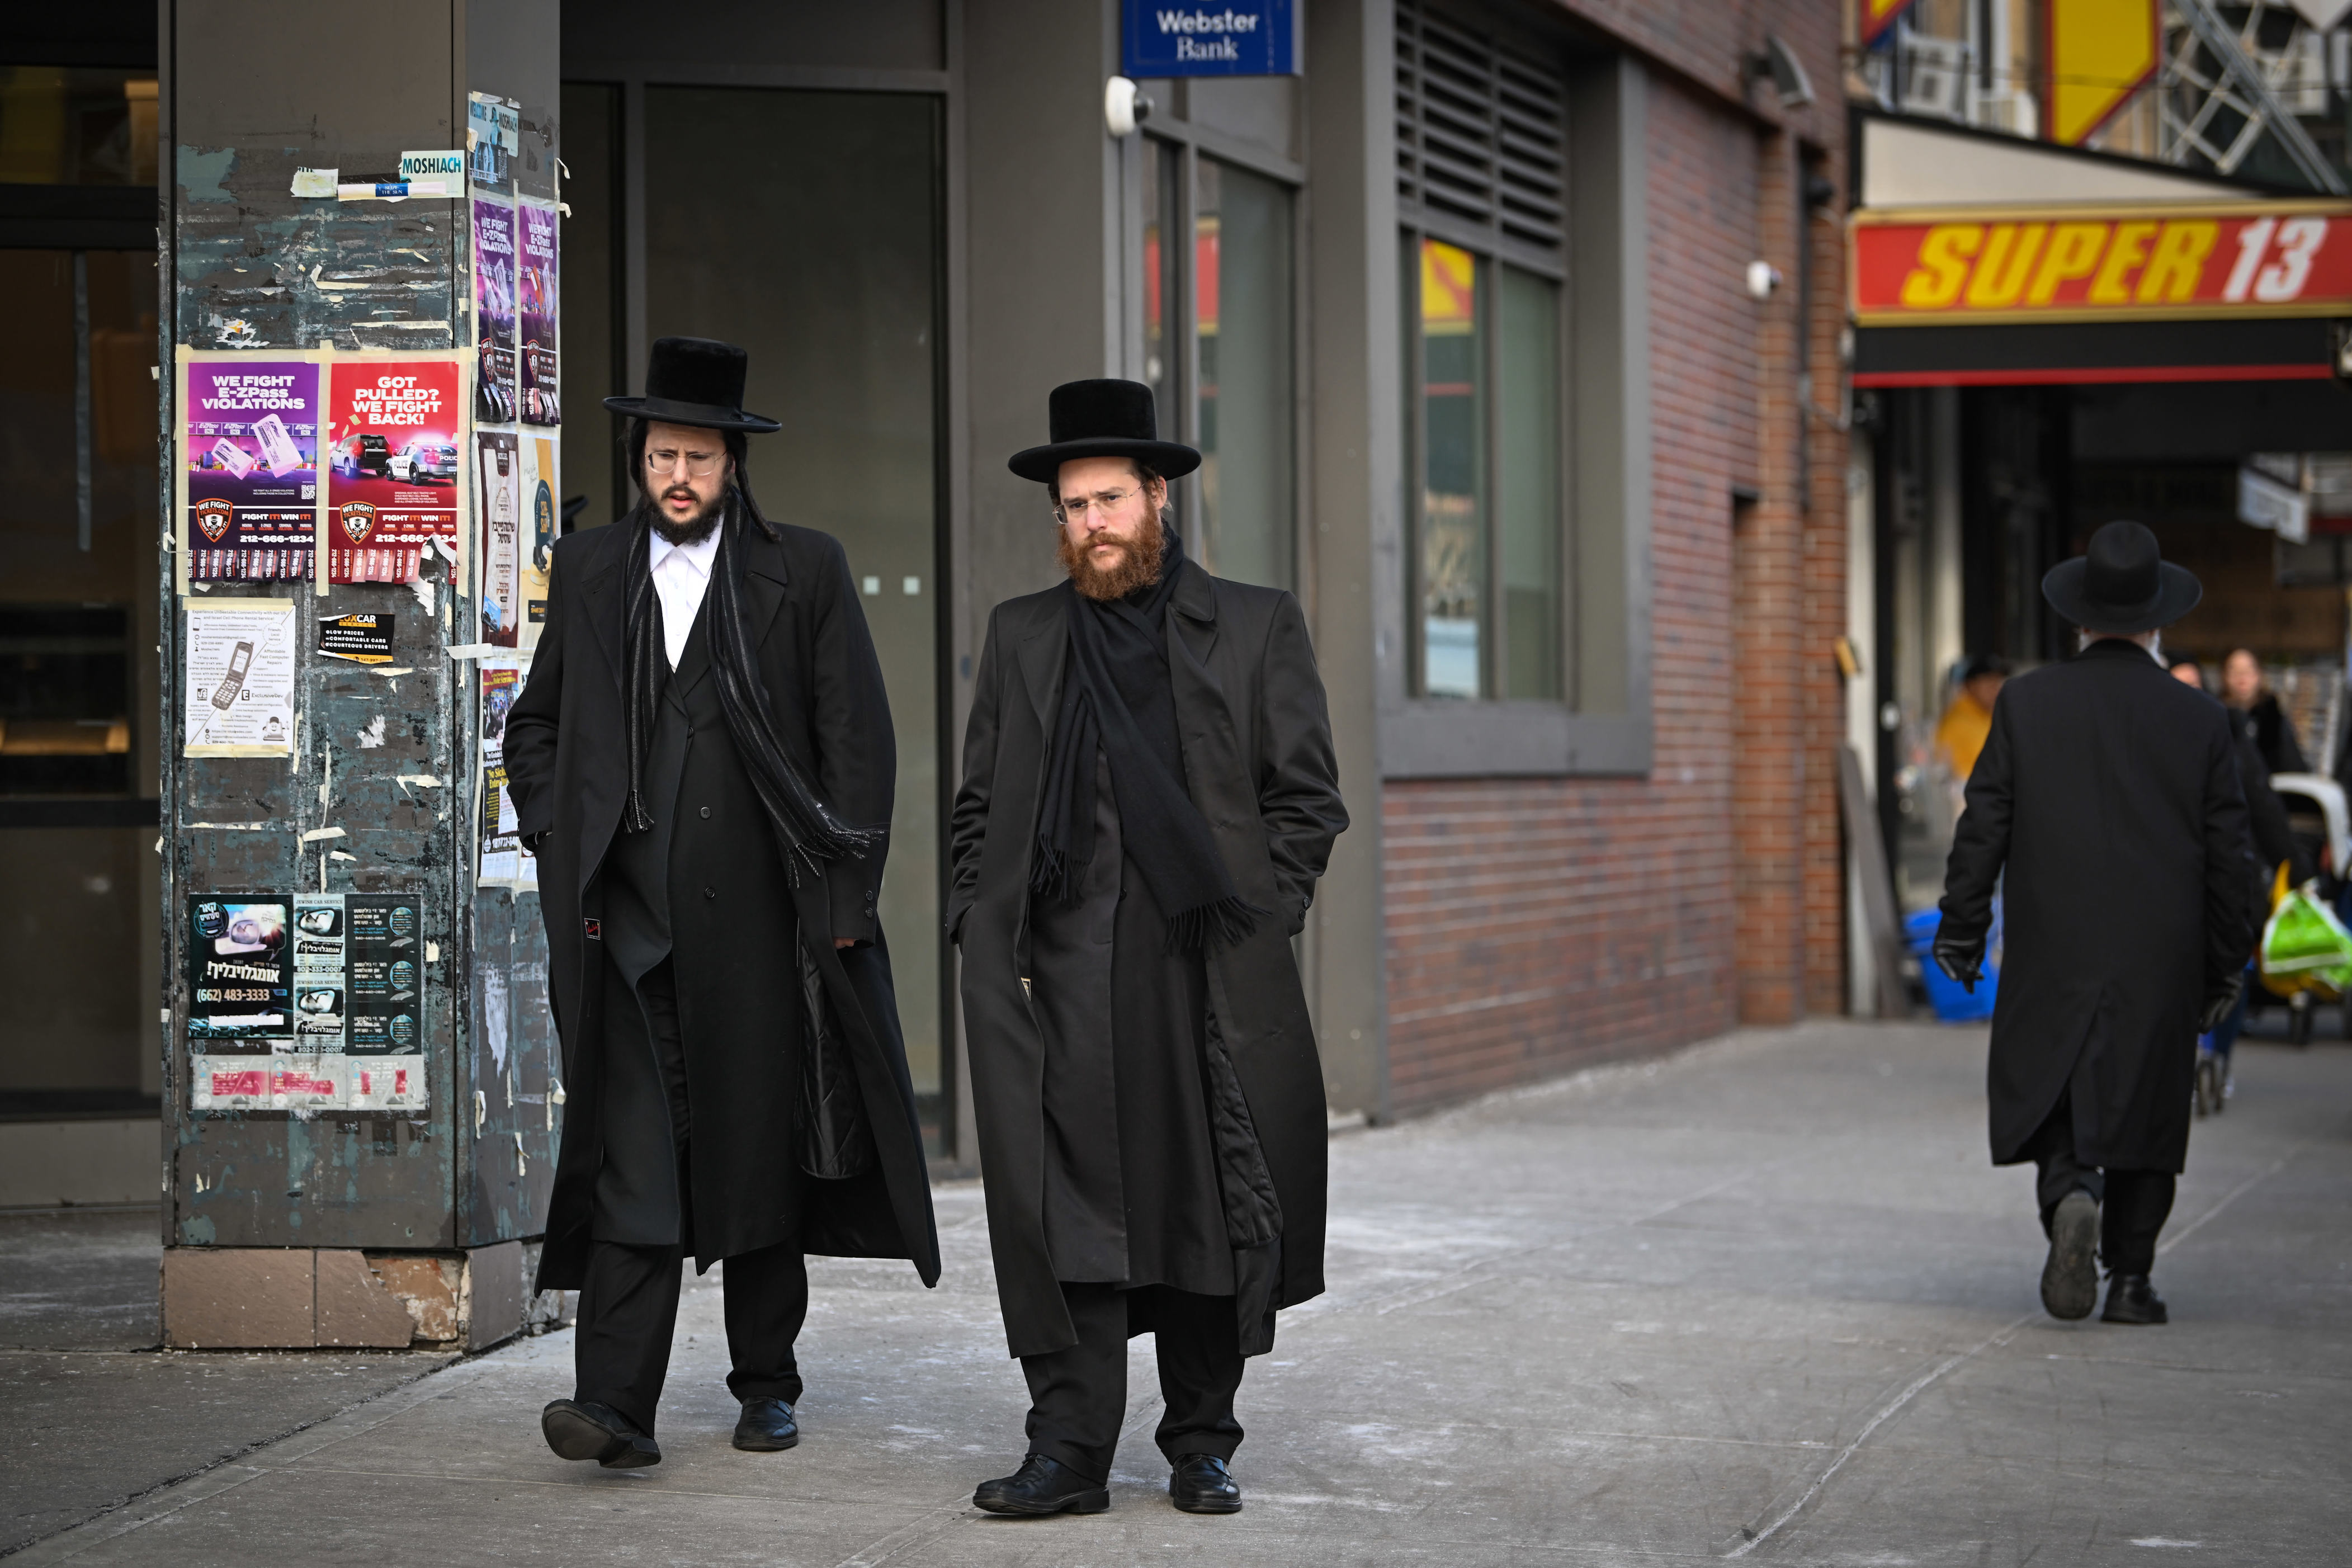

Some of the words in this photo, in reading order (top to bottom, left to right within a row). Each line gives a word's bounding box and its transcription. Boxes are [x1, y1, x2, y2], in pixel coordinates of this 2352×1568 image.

[1156, 8, 1259, 34] Webster
[1177, 35, 1239, 61] Bank
[470, 100, 487, 121] WELCOME
[402, 157, 461, 173] MOSHIACH
[481, 217, 490, 228] WE
[492, 219, 508, 232] FIGHT
[528, 223, 537, 234] WE
[526, 244, 553, 259] VIOLATIONS
[1901, 218, 2221, 309] SUPER
[2222, 214, 2328, 303] 13
[212, 376, 240, 386] WE
[243, 376, 295, 386] FIGHT
[378, 376, 417, 388] GOT
[219, 388, 289, 398] E-ZPass
[355, 389, 440, 400] PULLED?
[202, 398, 305, 409] VIOLATIONS
[352, 401, 382, 413] WE
[385, 401, 442, 413] FIGHT
[369, 413, 424, 425] BACK!
[199, 502, 209, 511] WE
[210, 501, 230, 511] FIGHT
[354, 504, 374, 513] FIGHT
[215, 527, 224, 536] WIN
[358, 530, 367, 539] WIN
[375, 534, 457, 542] 212-666-34
[199, 902, 216, 913] קאר
[207, 960, 280, 983] אומגלויבליך!
[197, 989, 222, 1003] (662)
[224, 989, 270, 1002] 483-3333
